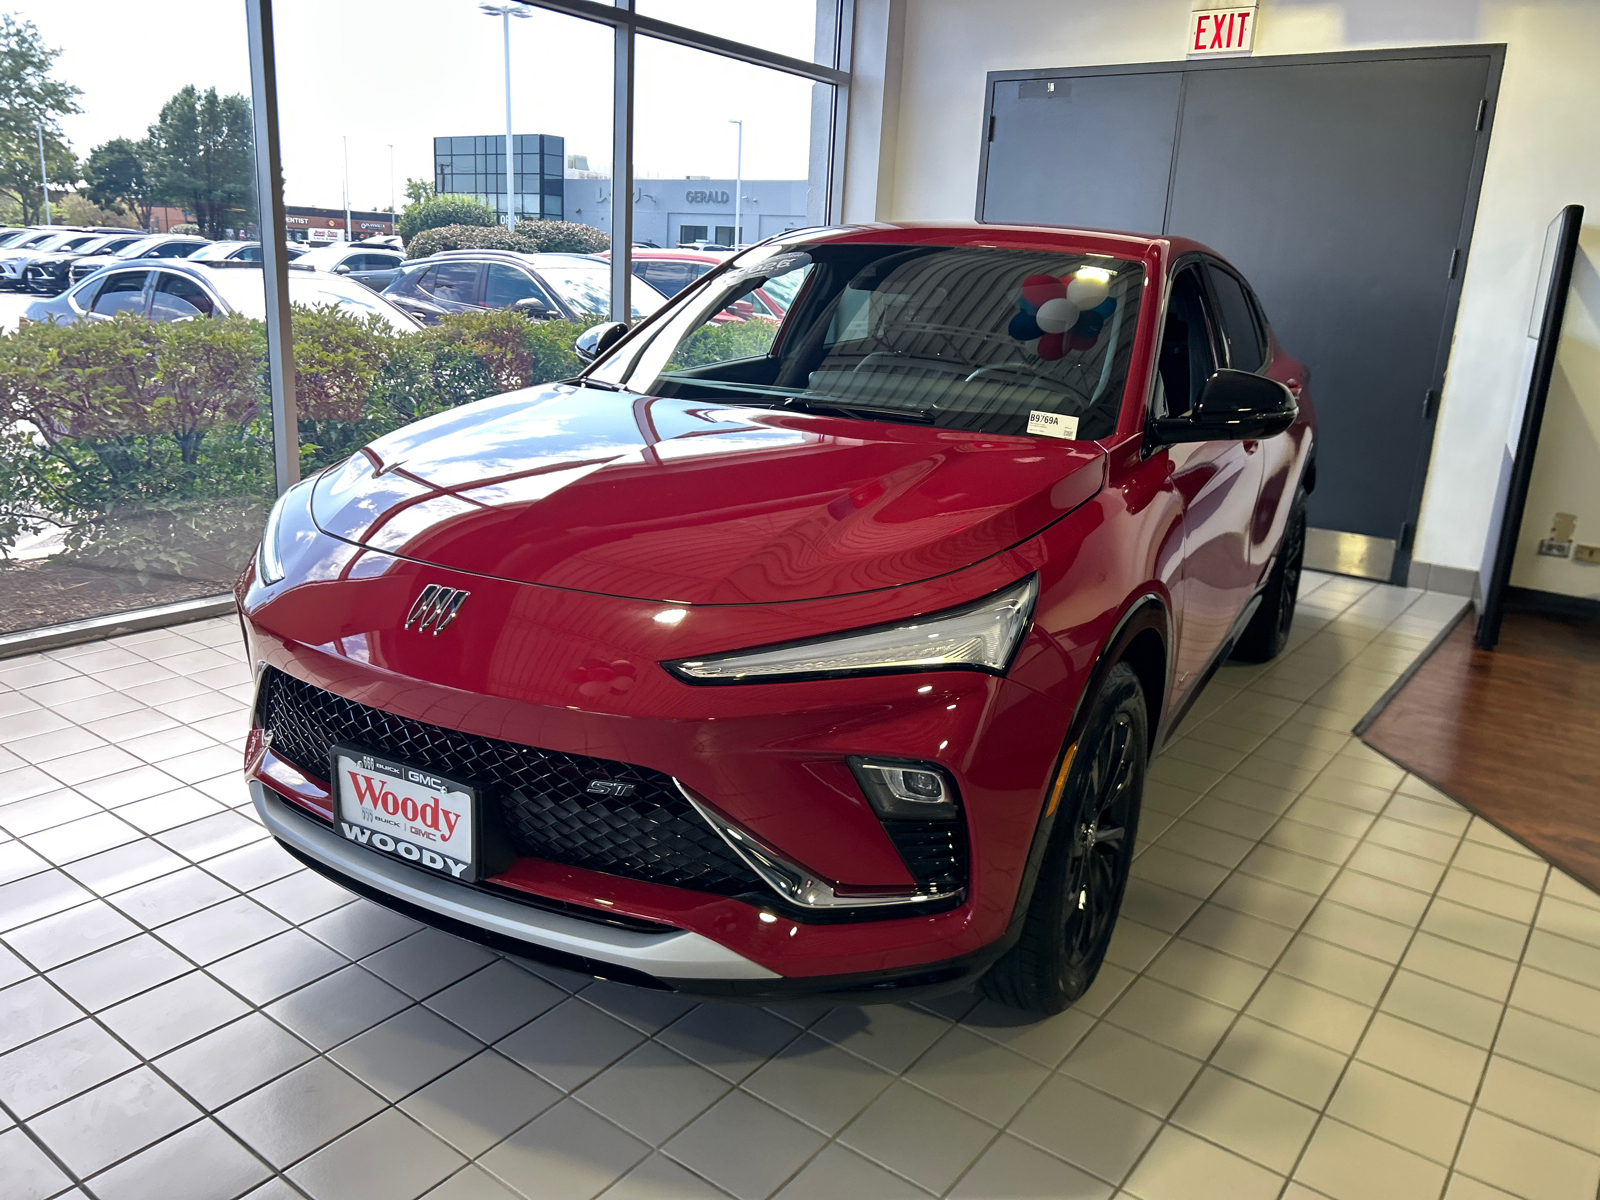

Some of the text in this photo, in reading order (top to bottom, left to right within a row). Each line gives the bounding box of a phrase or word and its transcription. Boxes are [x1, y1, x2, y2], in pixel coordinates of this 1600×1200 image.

[1194, 12, 1250, 50] EXIT
[685, 190, 729, 203] GERALD
[286, 217, 309, 225] ENTIST
[500, 214, 520, 225] OPN
[1030, 413, 1058, 425] B9769A
[376, 763, 442, 790] BUICK GMC
[586, 780, 635, 796] ST
[347, 770, 461, 842] Woody
[375, 815, 437, 842] BUICK GMC
[341, 822, 468, 878] WOODY
